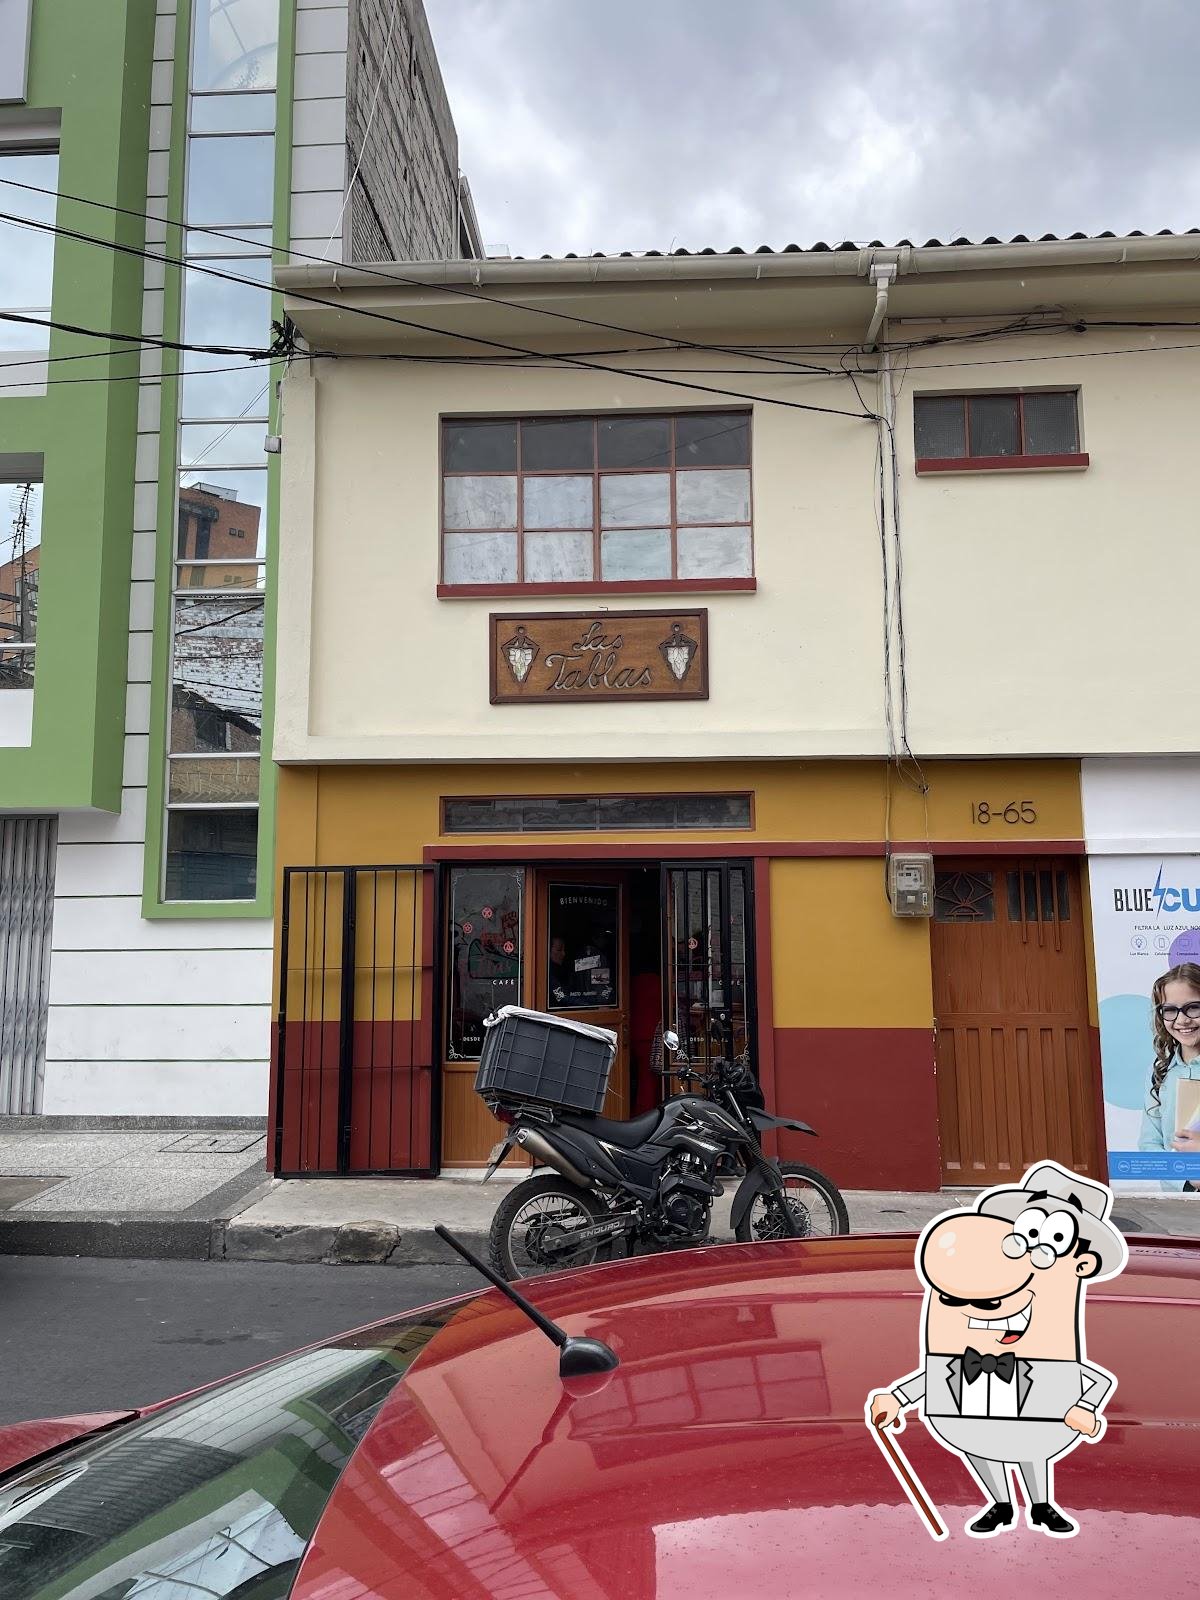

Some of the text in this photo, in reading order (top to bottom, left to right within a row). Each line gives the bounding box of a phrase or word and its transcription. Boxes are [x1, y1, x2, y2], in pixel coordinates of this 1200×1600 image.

[573, 621, 624, 651] Las
[545, 652, 651, 691] Tablas
[971, 801, 1037, 825] 18-65
[559, 896, 608, 906] BIENVENIDO
[1113, 888, 1154, 911] BLUE
[579, 1221, 620, 1239] ENDURO
